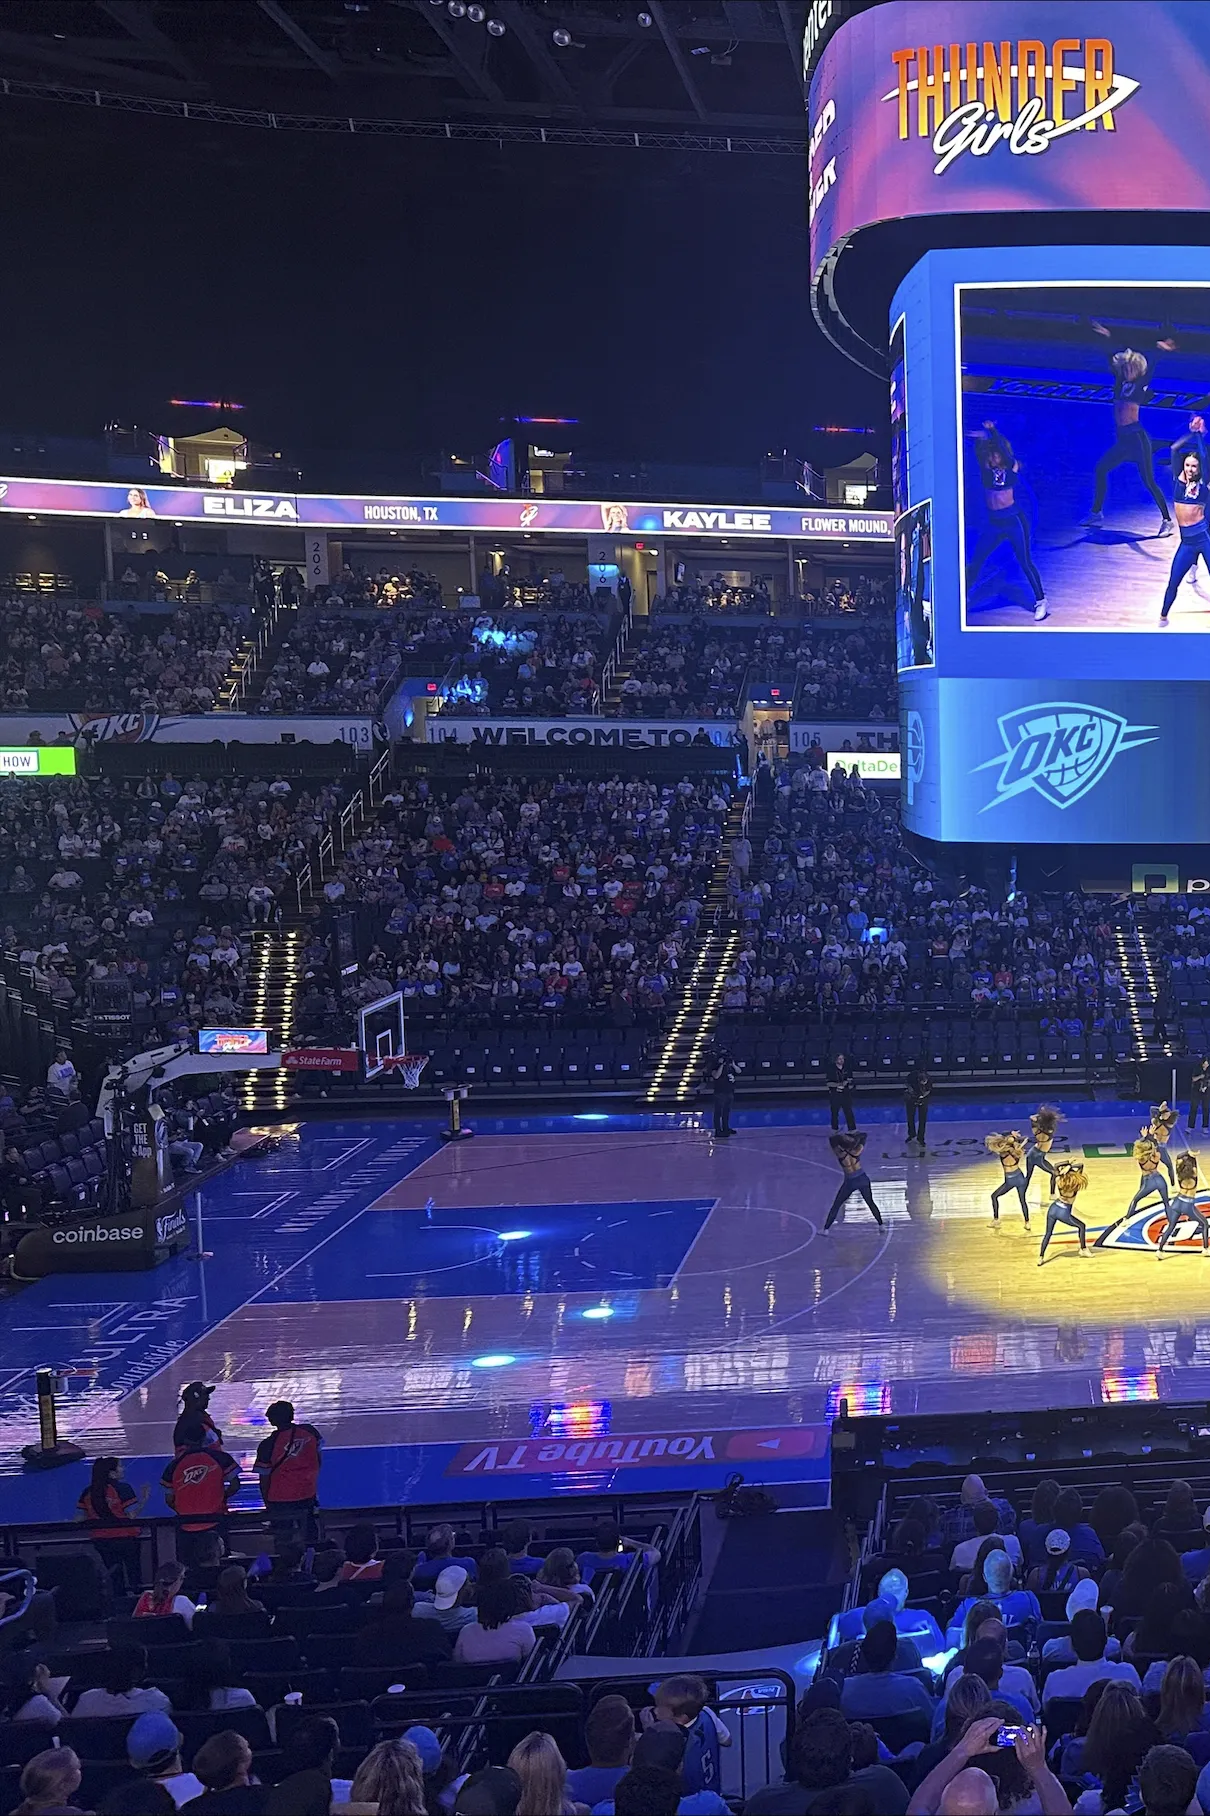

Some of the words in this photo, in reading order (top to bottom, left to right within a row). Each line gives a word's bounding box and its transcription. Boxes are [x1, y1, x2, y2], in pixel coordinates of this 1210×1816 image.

[892, 38, 1118, 140] THUNDER
[933, 97, 1060, 175] Girls
[203, 495, 299, 519] ELIZA
[364, 505, 421, 522] HOUSTON,
[423, 508, 438, 521] TX
[663, 511, 772, 531] KAYLEE
[801, 517, 846, 532] FLOWER
[849, 519, 892, 536] MOUND,
[338, 726, 370, 744] 103
[472, 726, 642, 747] WELCOME
[651, 729, 691, 747] TO
[1012, 721, 1098, 777] OKC
[3, 755, 32, 768] HOW
[134, 1123, 148, 1134] GET
[134, 1134, 148, 1145] THE
[52, 1225, 144, 1244] coinbase
[463, 1445, 530, 1473] TV
[537, 1436, 716, 1468] YouTube
